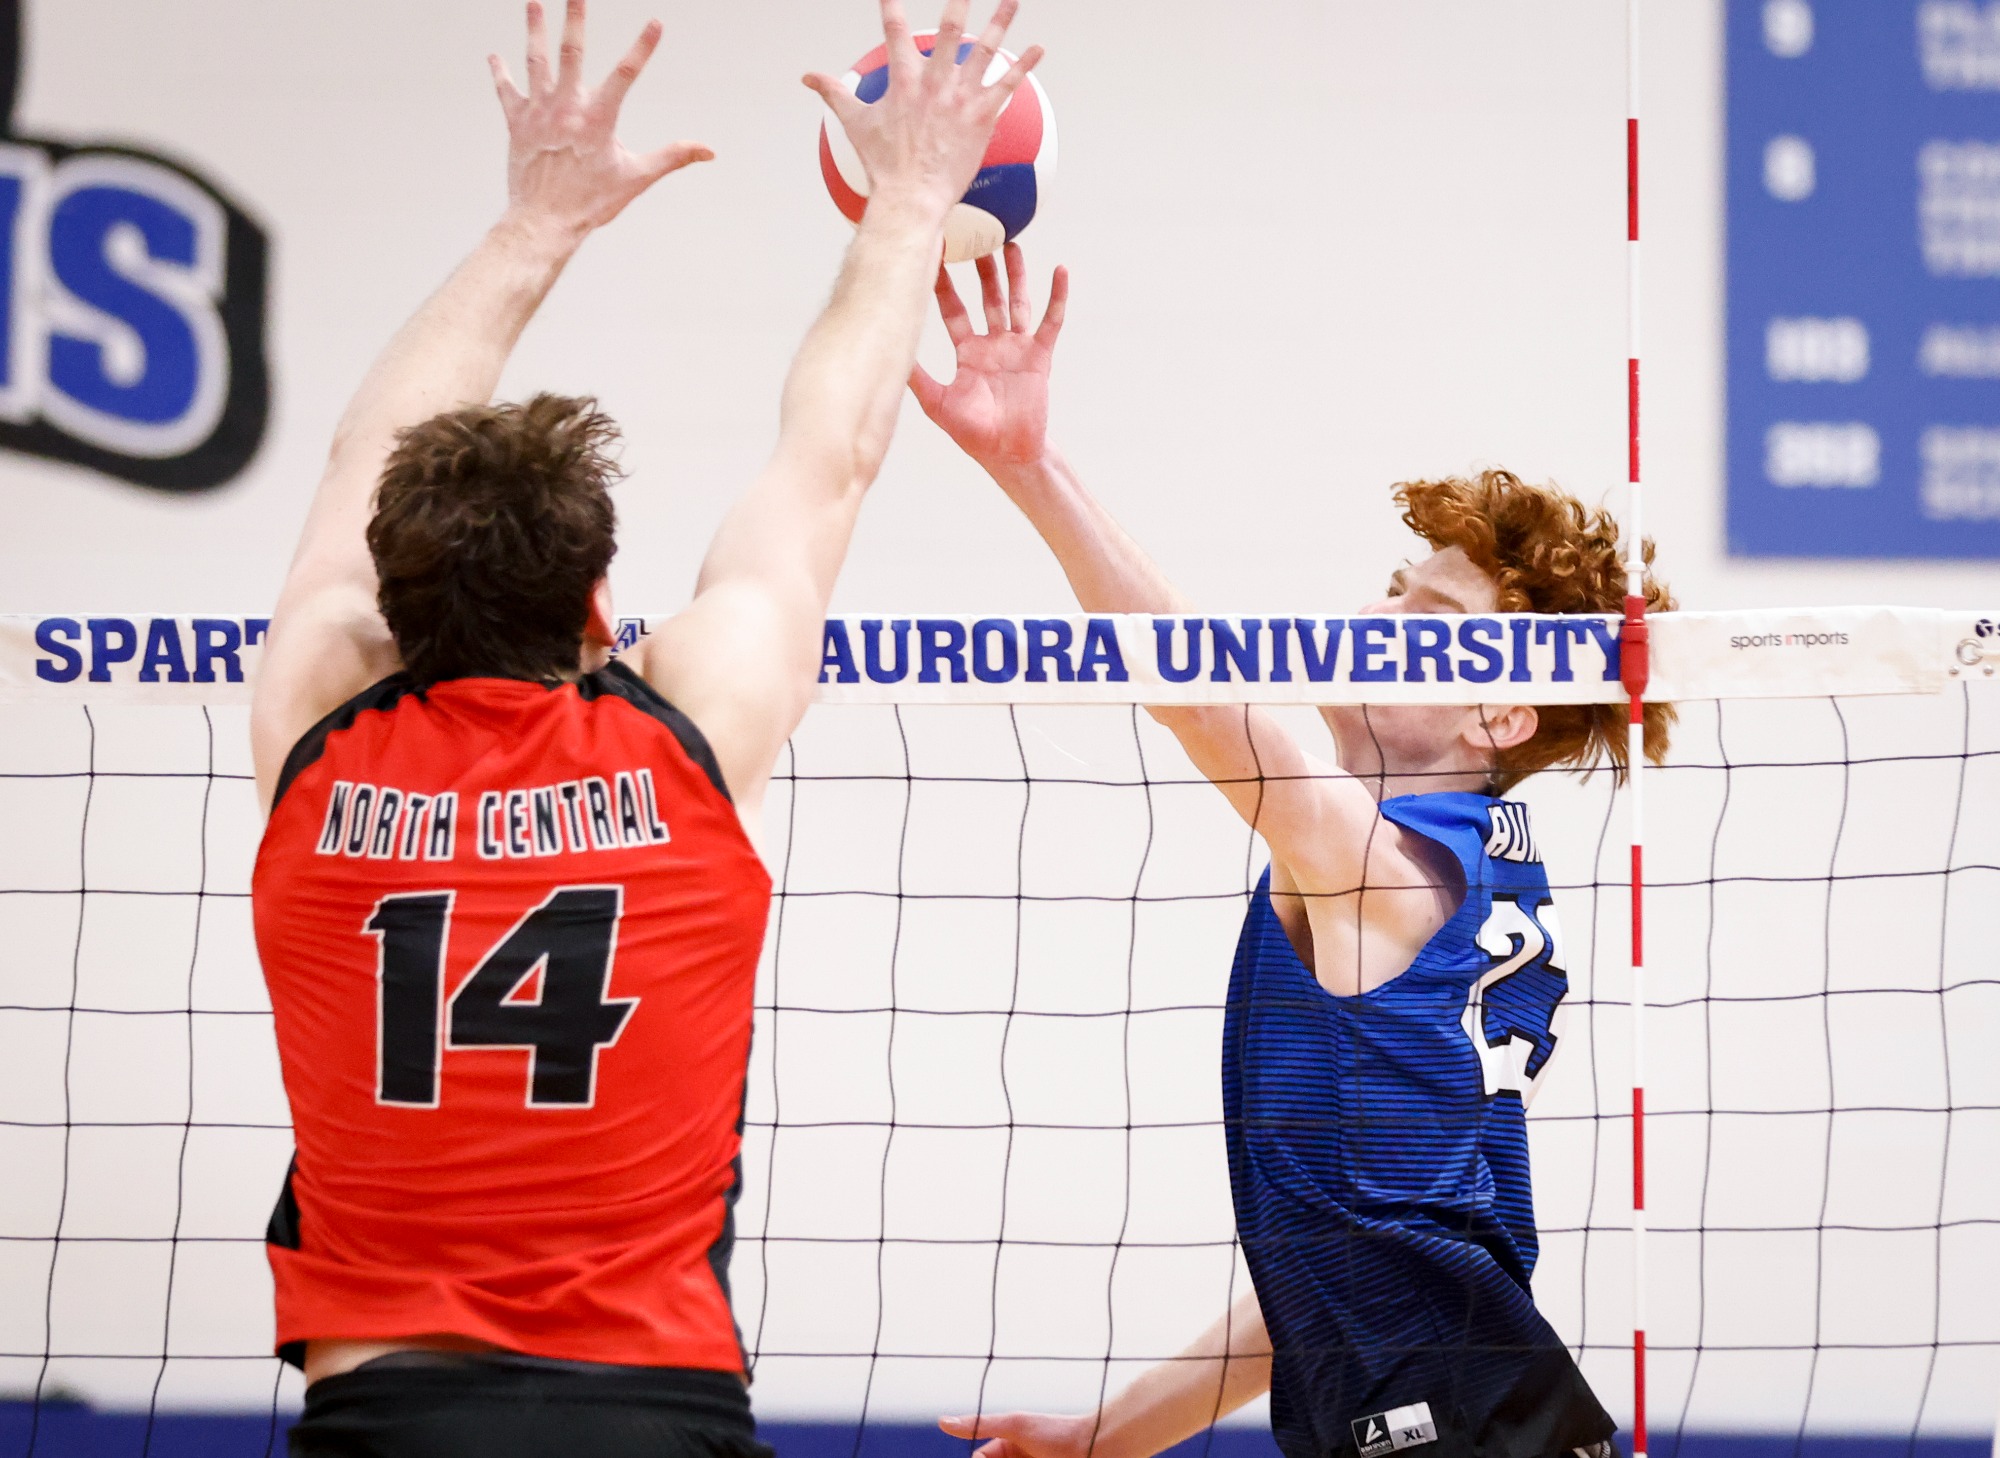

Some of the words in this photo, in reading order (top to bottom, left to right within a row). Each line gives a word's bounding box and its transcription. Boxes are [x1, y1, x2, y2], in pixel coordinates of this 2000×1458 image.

[817, 618, 1128, 684] AURORA
[1152, 617, 1626, 683] UNIVERSITY
[1731, 633, 1782, 650] sports
[315, 780, 459, 861] NORTH
[477, 768, 671, 860] CENTRAL
[360, 884, 641, 1110] 14
[1403, 1428, 1425, 1443] XL
